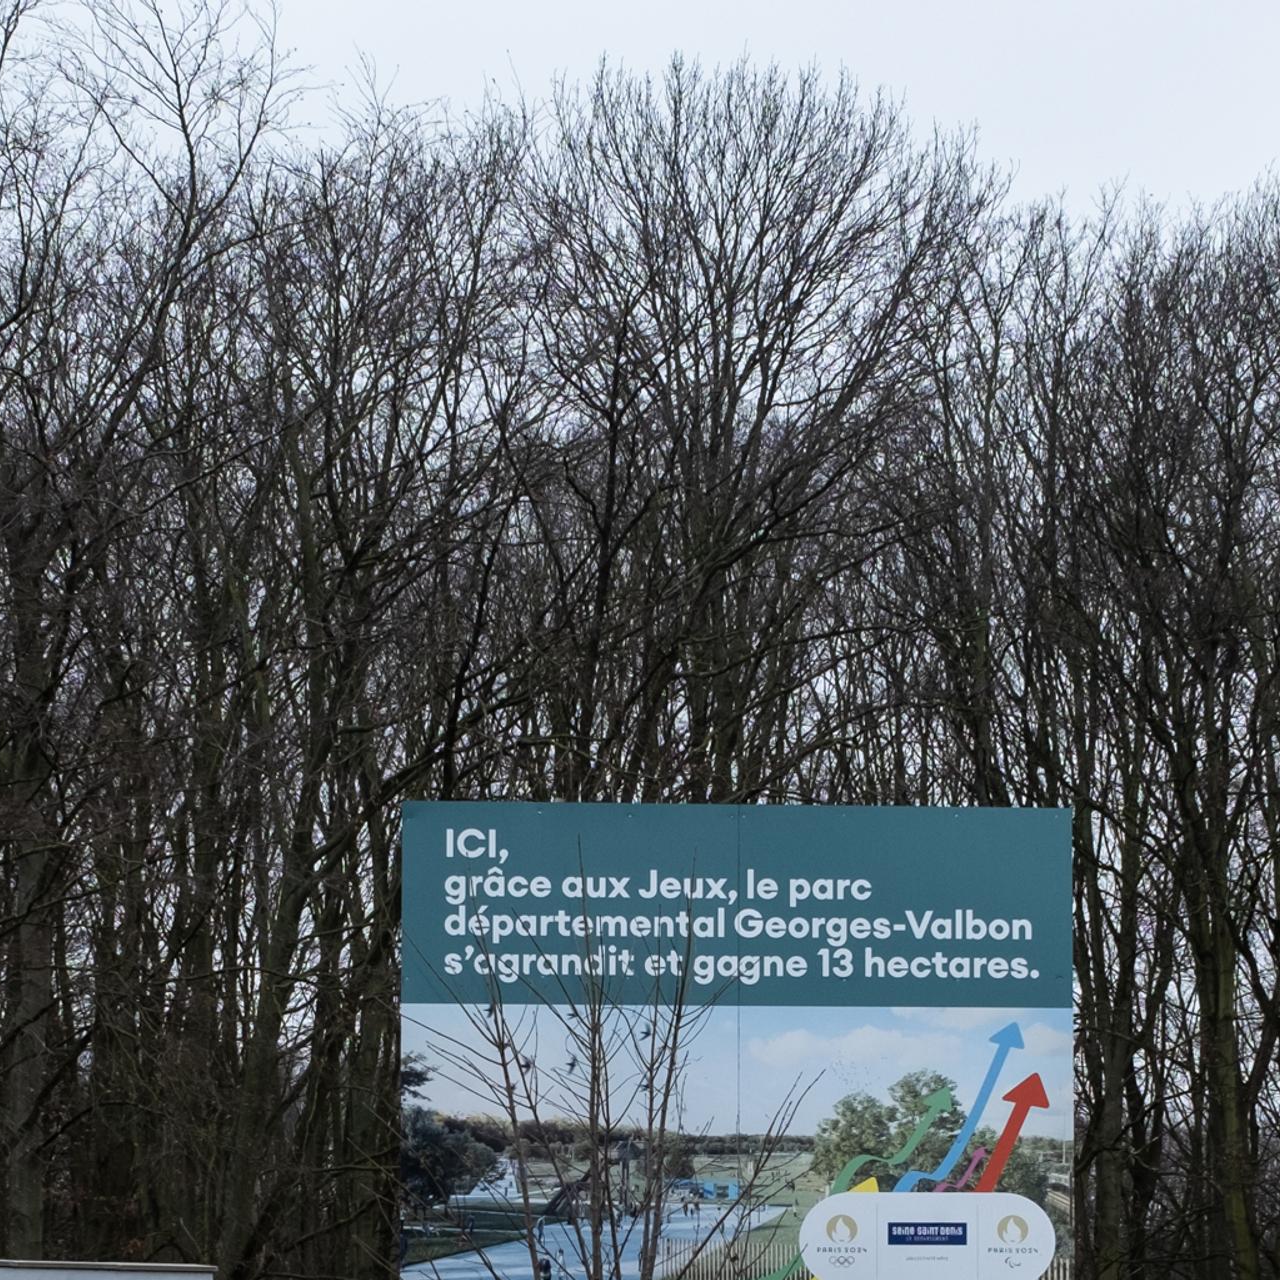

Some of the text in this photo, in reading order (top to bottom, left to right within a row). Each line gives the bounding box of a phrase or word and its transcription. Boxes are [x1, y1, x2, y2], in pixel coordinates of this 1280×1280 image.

[446, 829, 508, 864] ICI,
[444, 866, 872, 907] grâce aux Jeux, le parc
[444, 905, 1032, 947] départemental Georges-Valbon
[645, 949, 683, 977] et
[693, 955, 808, 985] gagne
[817, 948, 854, 977] 13
[865, 947, 1039, 979] hectares.
